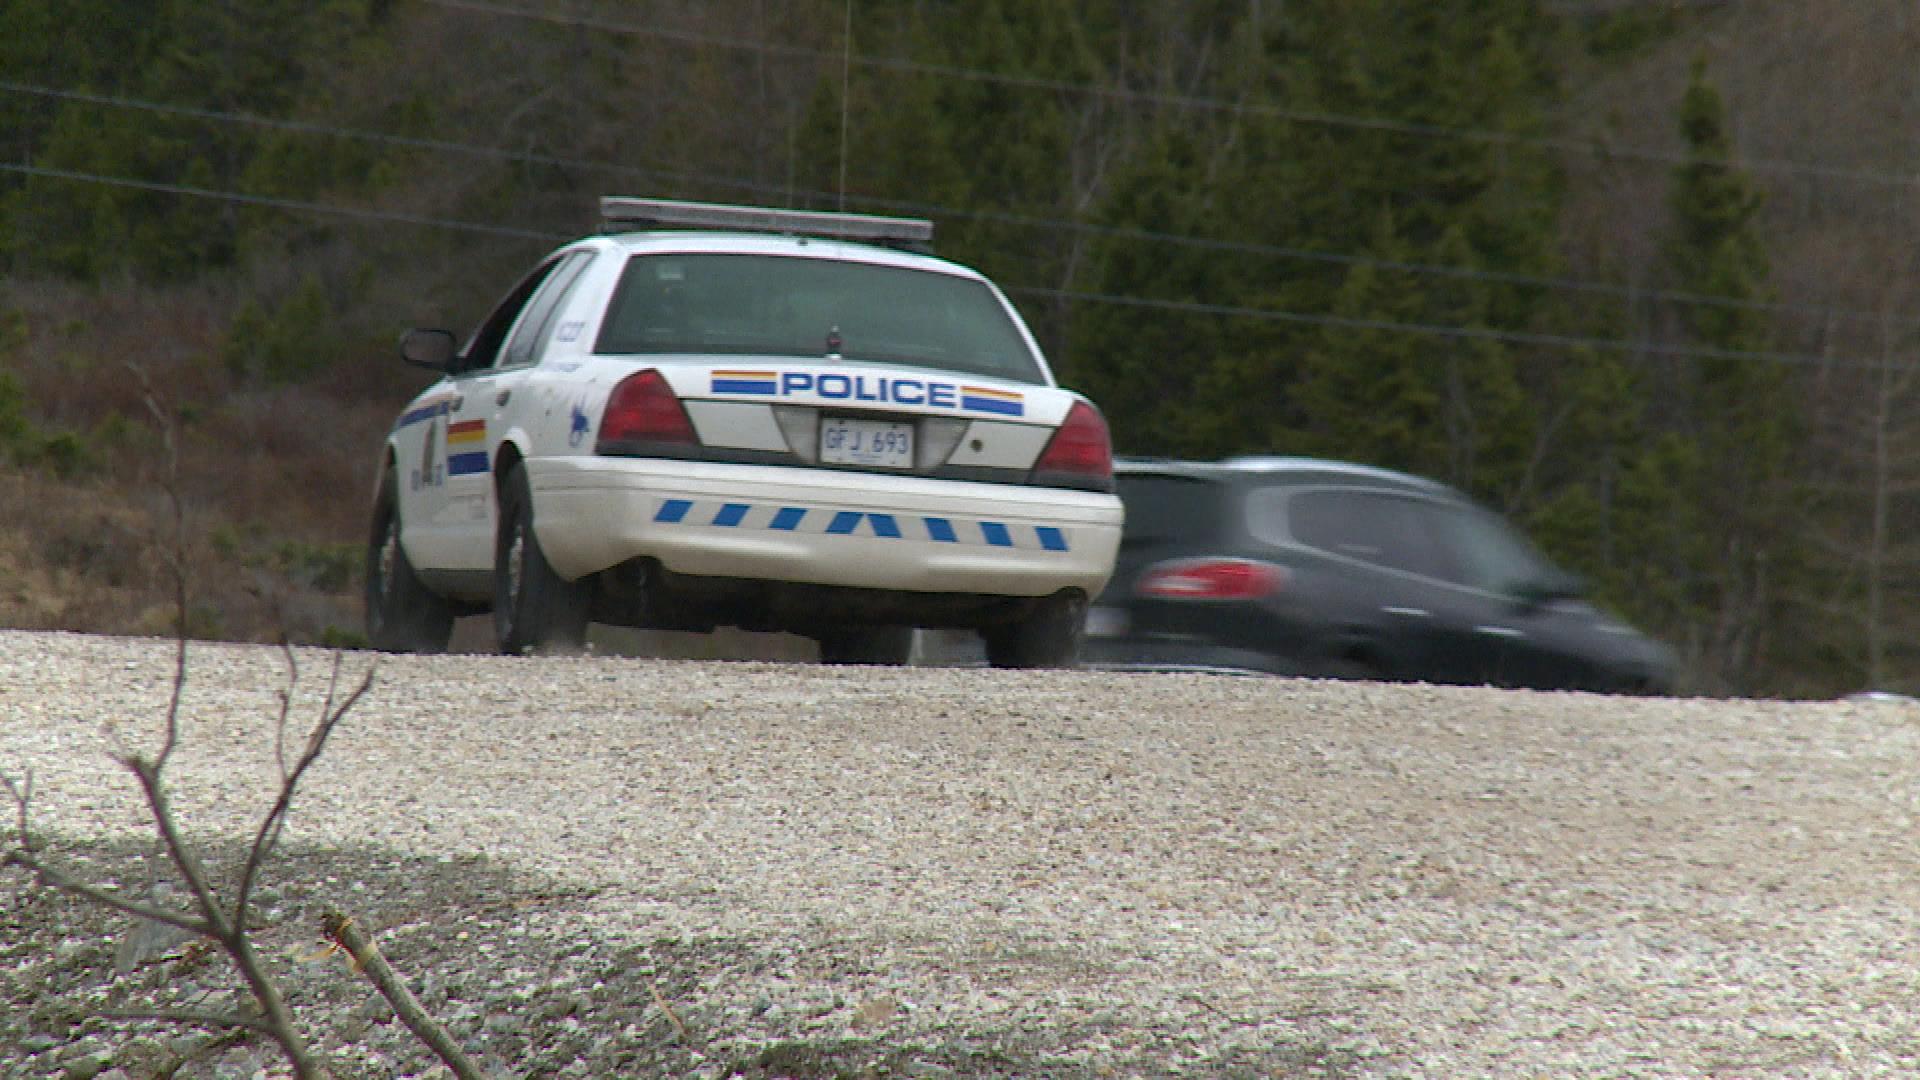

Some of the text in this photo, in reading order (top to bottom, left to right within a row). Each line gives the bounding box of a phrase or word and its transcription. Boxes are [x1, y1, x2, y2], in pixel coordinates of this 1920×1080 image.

[782, 372, 956, 408] POLICE
[825, 427, 909, 455] GFJ 693
